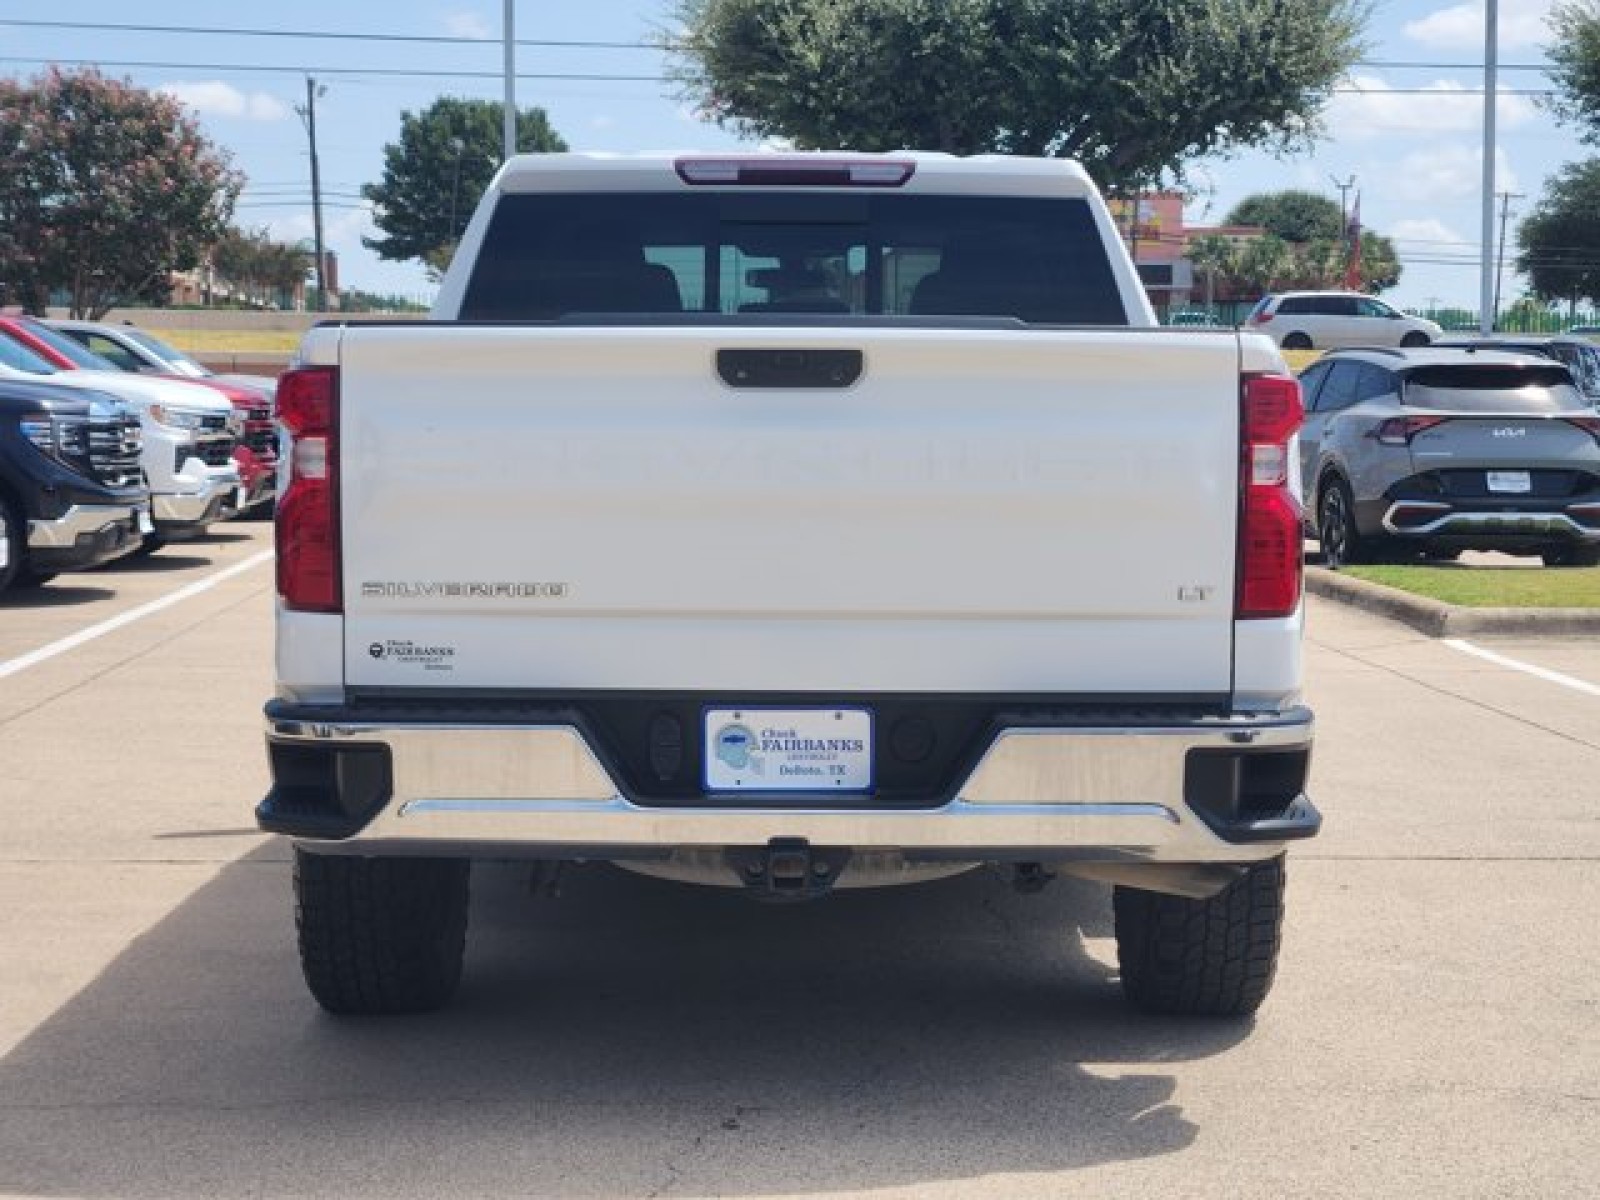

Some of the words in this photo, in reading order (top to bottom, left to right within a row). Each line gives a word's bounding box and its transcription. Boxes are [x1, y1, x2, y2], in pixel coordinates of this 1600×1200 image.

[361, 582, 569, 598] SILVERADO
[1177, 583, 1217, 601] LT
[761, 729, 796, 738] Chuck
[761, 739, 864, 751] FAIRBANKS
